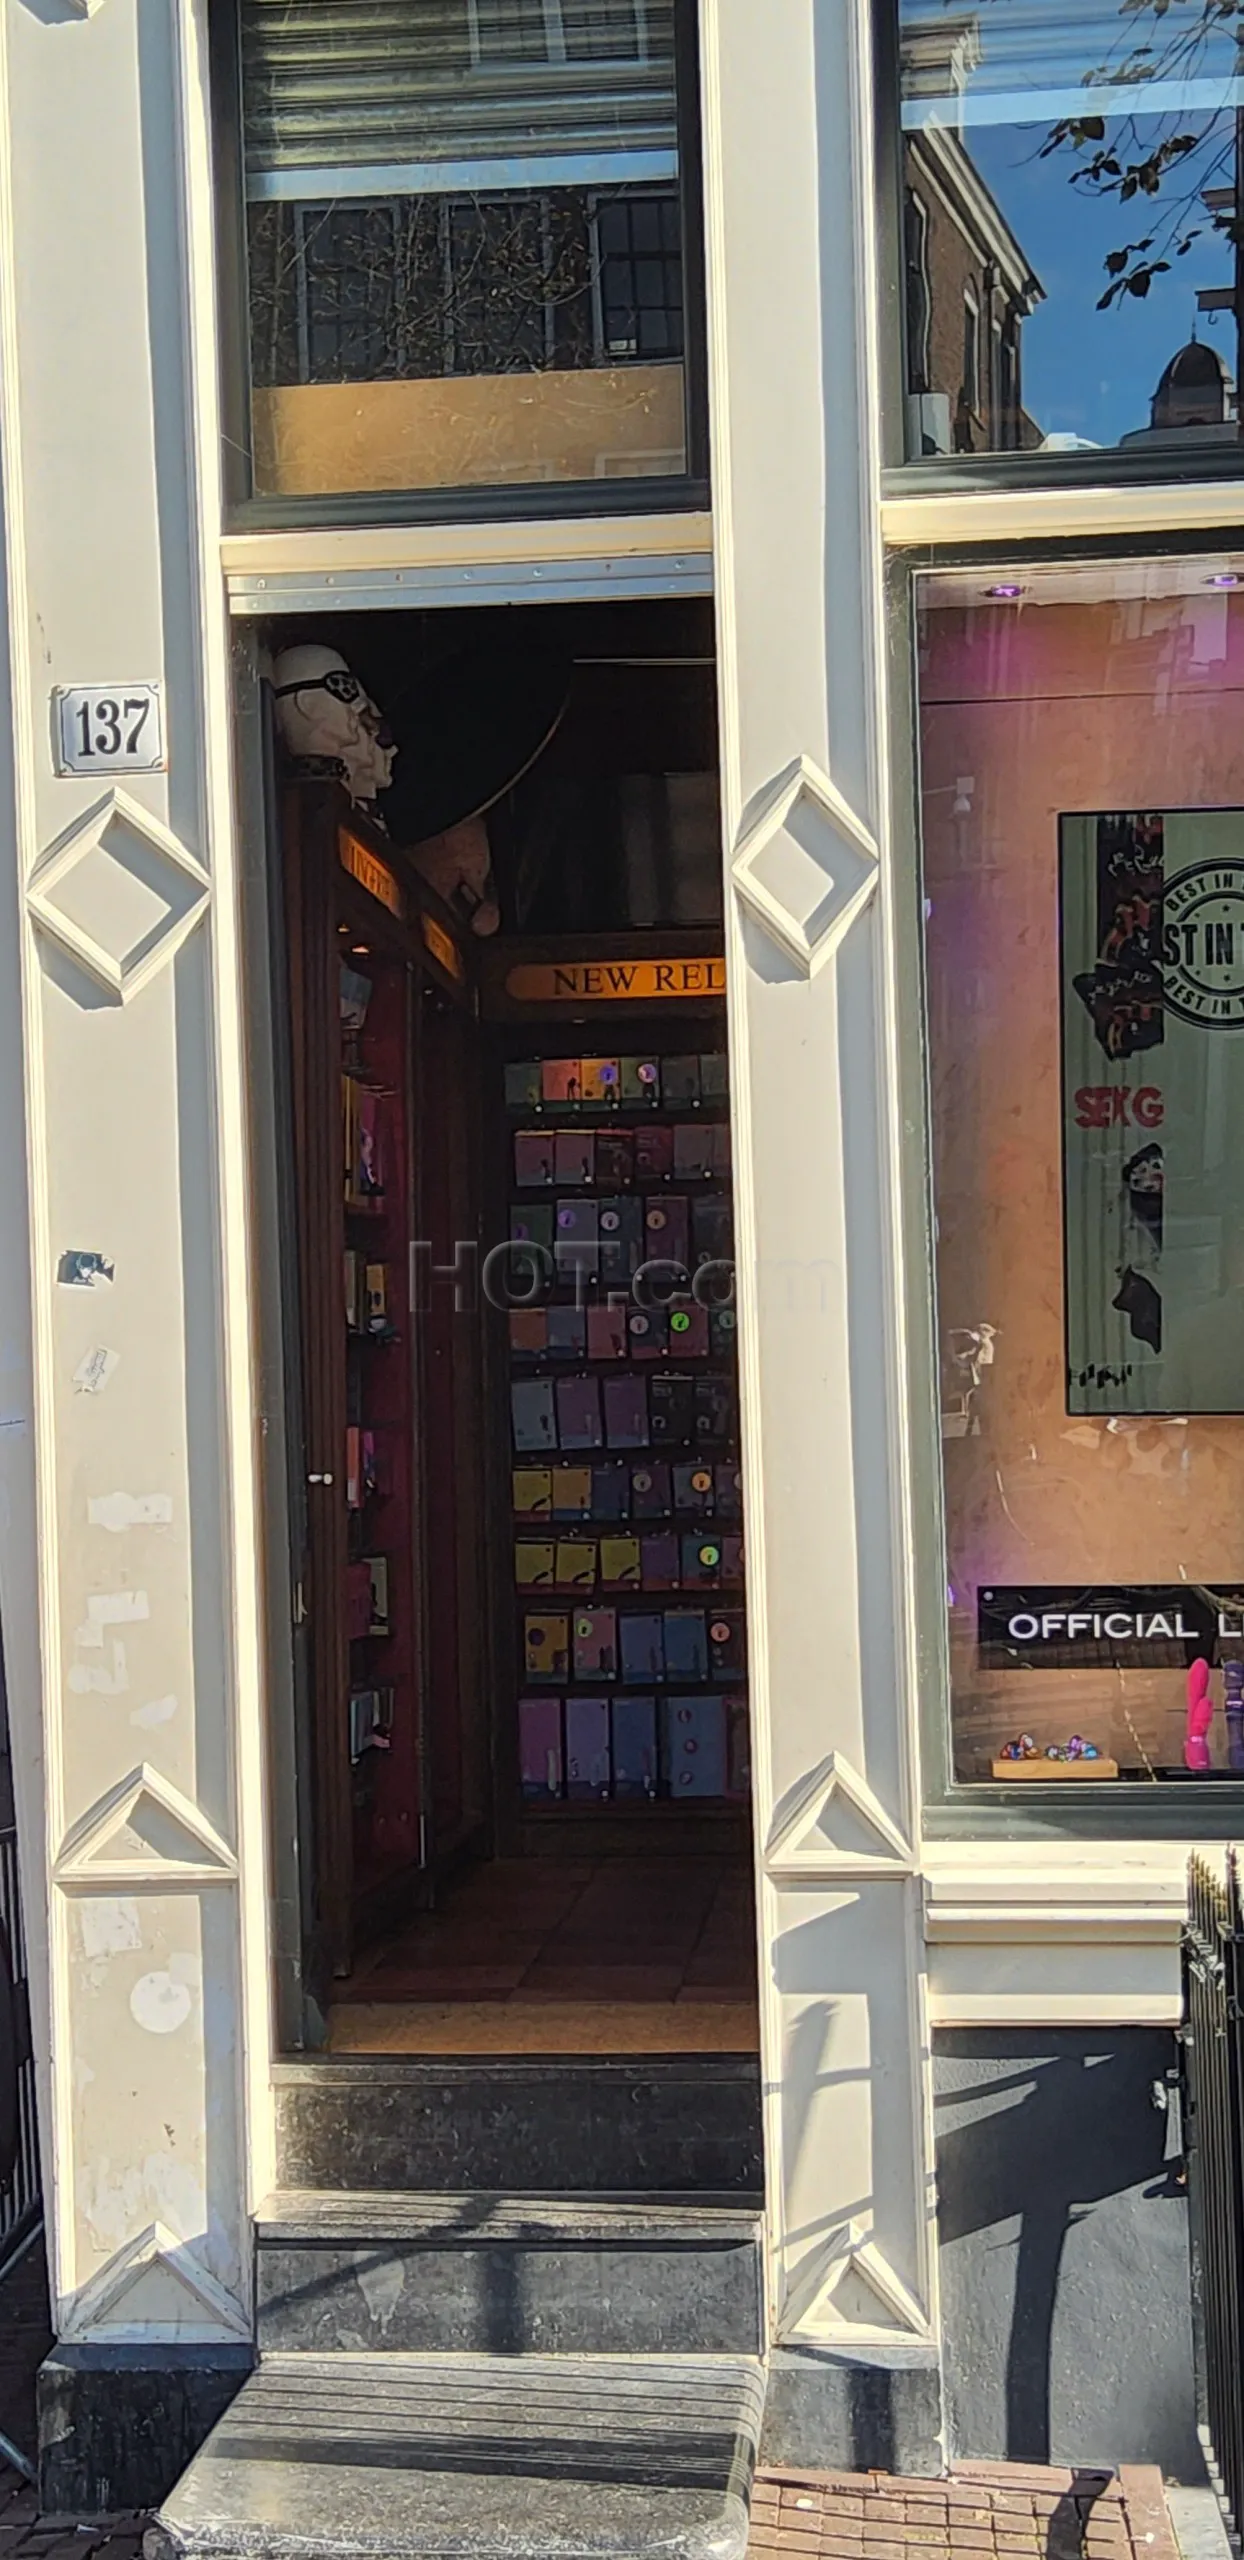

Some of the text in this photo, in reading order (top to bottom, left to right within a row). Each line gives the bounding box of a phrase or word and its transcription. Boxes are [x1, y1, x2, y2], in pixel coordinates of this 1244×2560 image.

[76, 699, 150, 757] 137
[1165, 872, 1233, 912] BEST IN
[1205, 922, 1233, 965] IN
[552, 965, 640, 995] NEW
[1163, 975, 1206, 1010] BEST
[1212, 999, 1231, 1015] IN
[1008, 1612, 1244, 1640] OFFICIAL L
